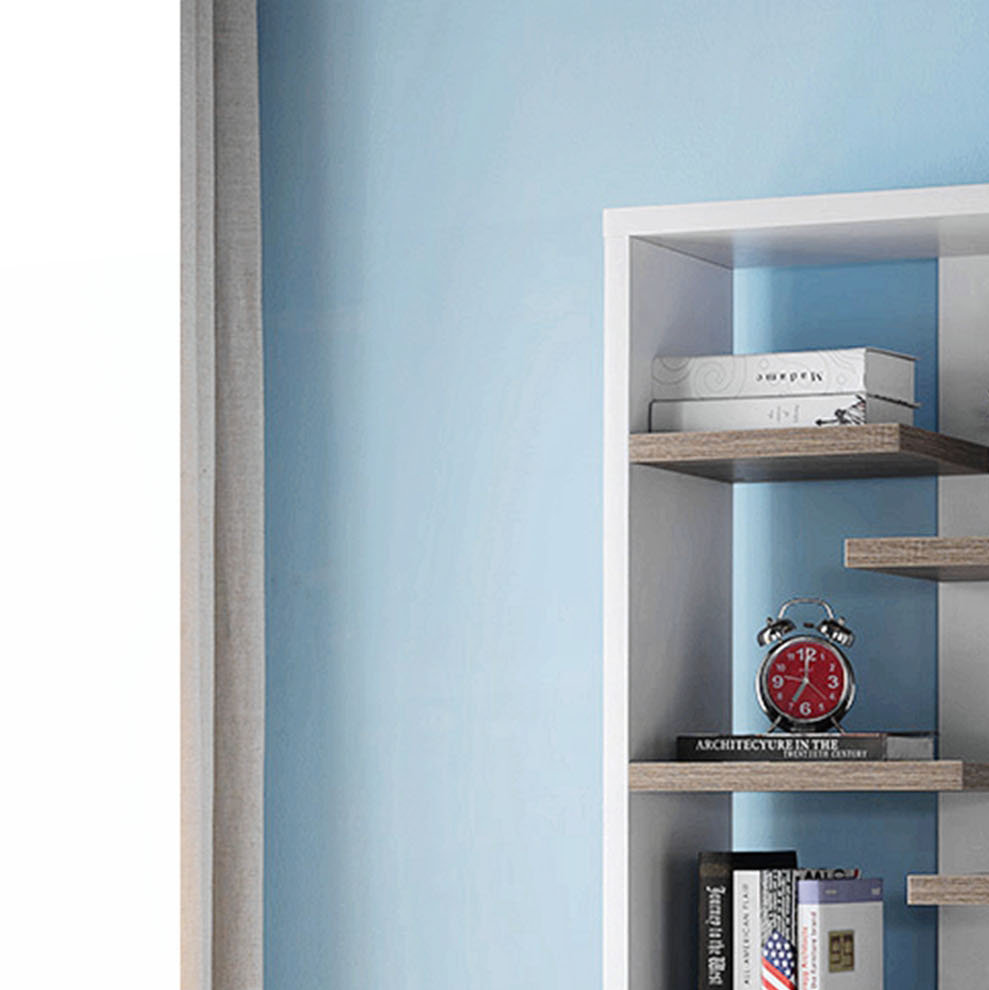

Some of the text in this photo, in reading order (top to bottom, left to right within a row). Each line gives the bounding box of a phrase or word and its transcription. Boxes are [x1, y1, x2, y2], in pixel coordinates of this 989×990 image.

[796, 648, 817, 662] 12
[772, 675, 784, 688] 9
[827, 675, 839, 688] 3
[800, 701, 812, 716] 6
[795, 739, 809, 751] IN
[811, 739, 838, 751] THE
